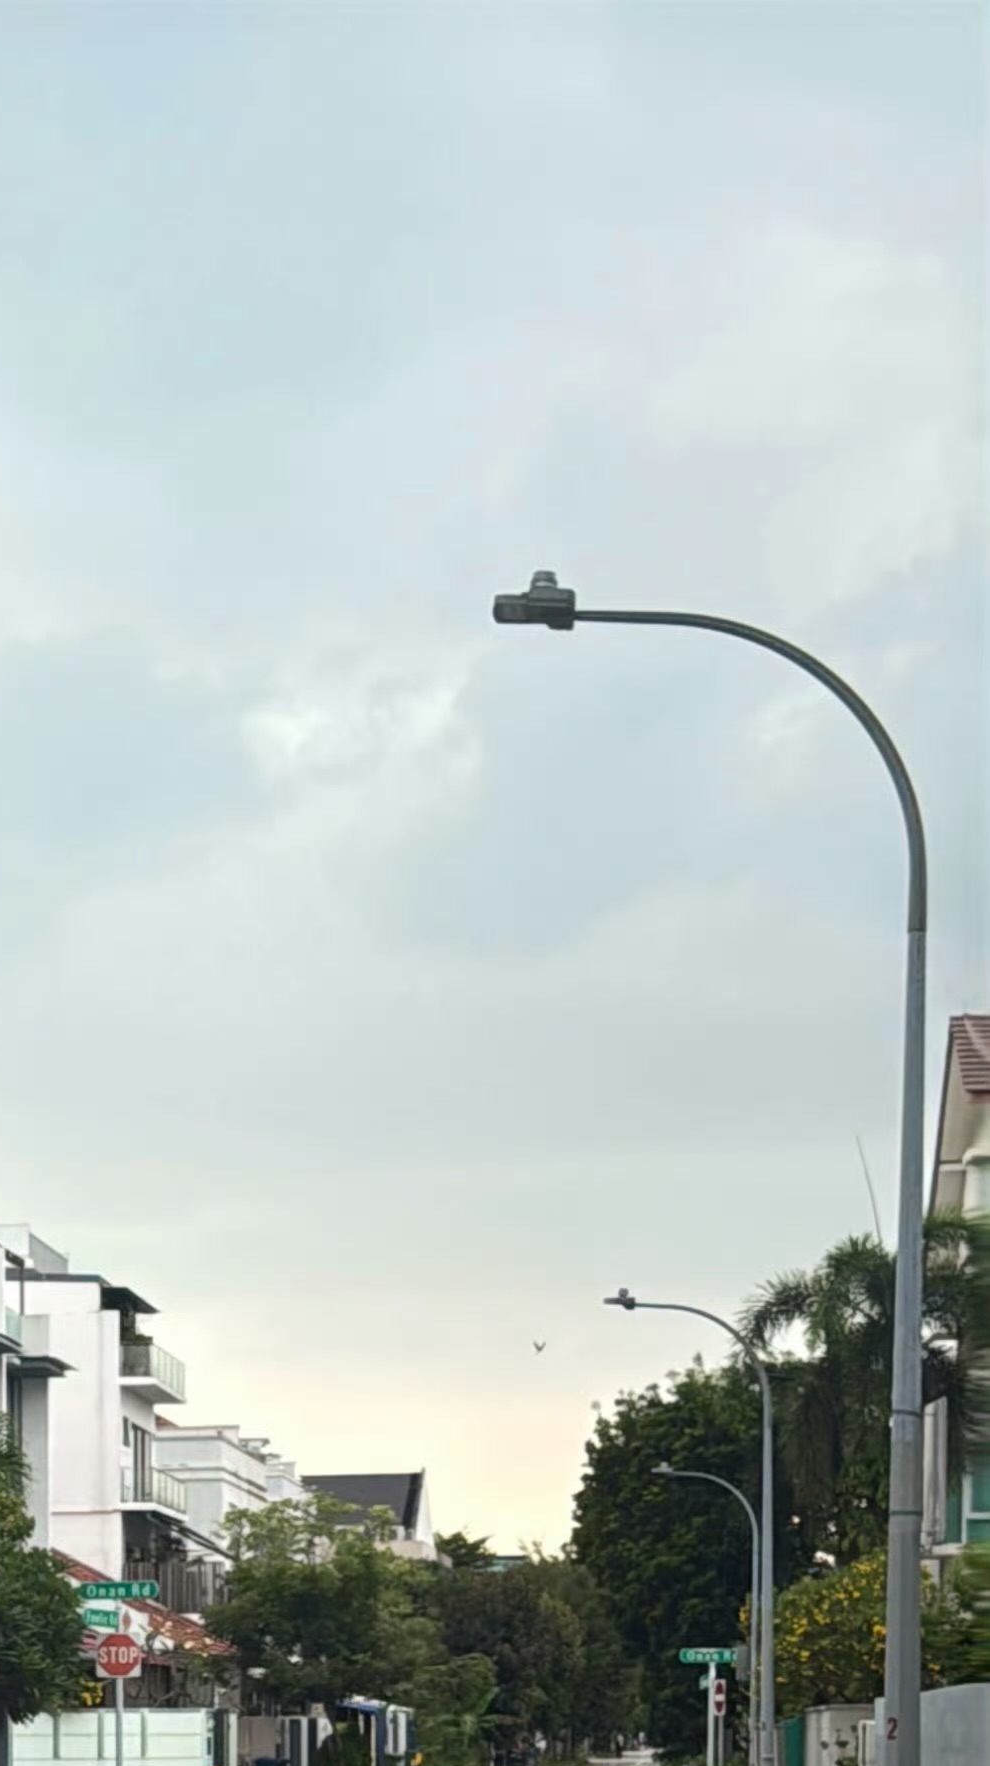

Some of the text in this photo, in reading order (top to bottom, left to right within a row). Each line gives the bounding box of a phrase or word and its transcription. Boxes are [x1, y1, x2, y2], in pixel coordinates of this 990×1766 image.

[86, 1583, 151, 1597] Onan Rd
[98, 1646, 138, 1664] STOP
[887, 1717, 898, 1741] 2
